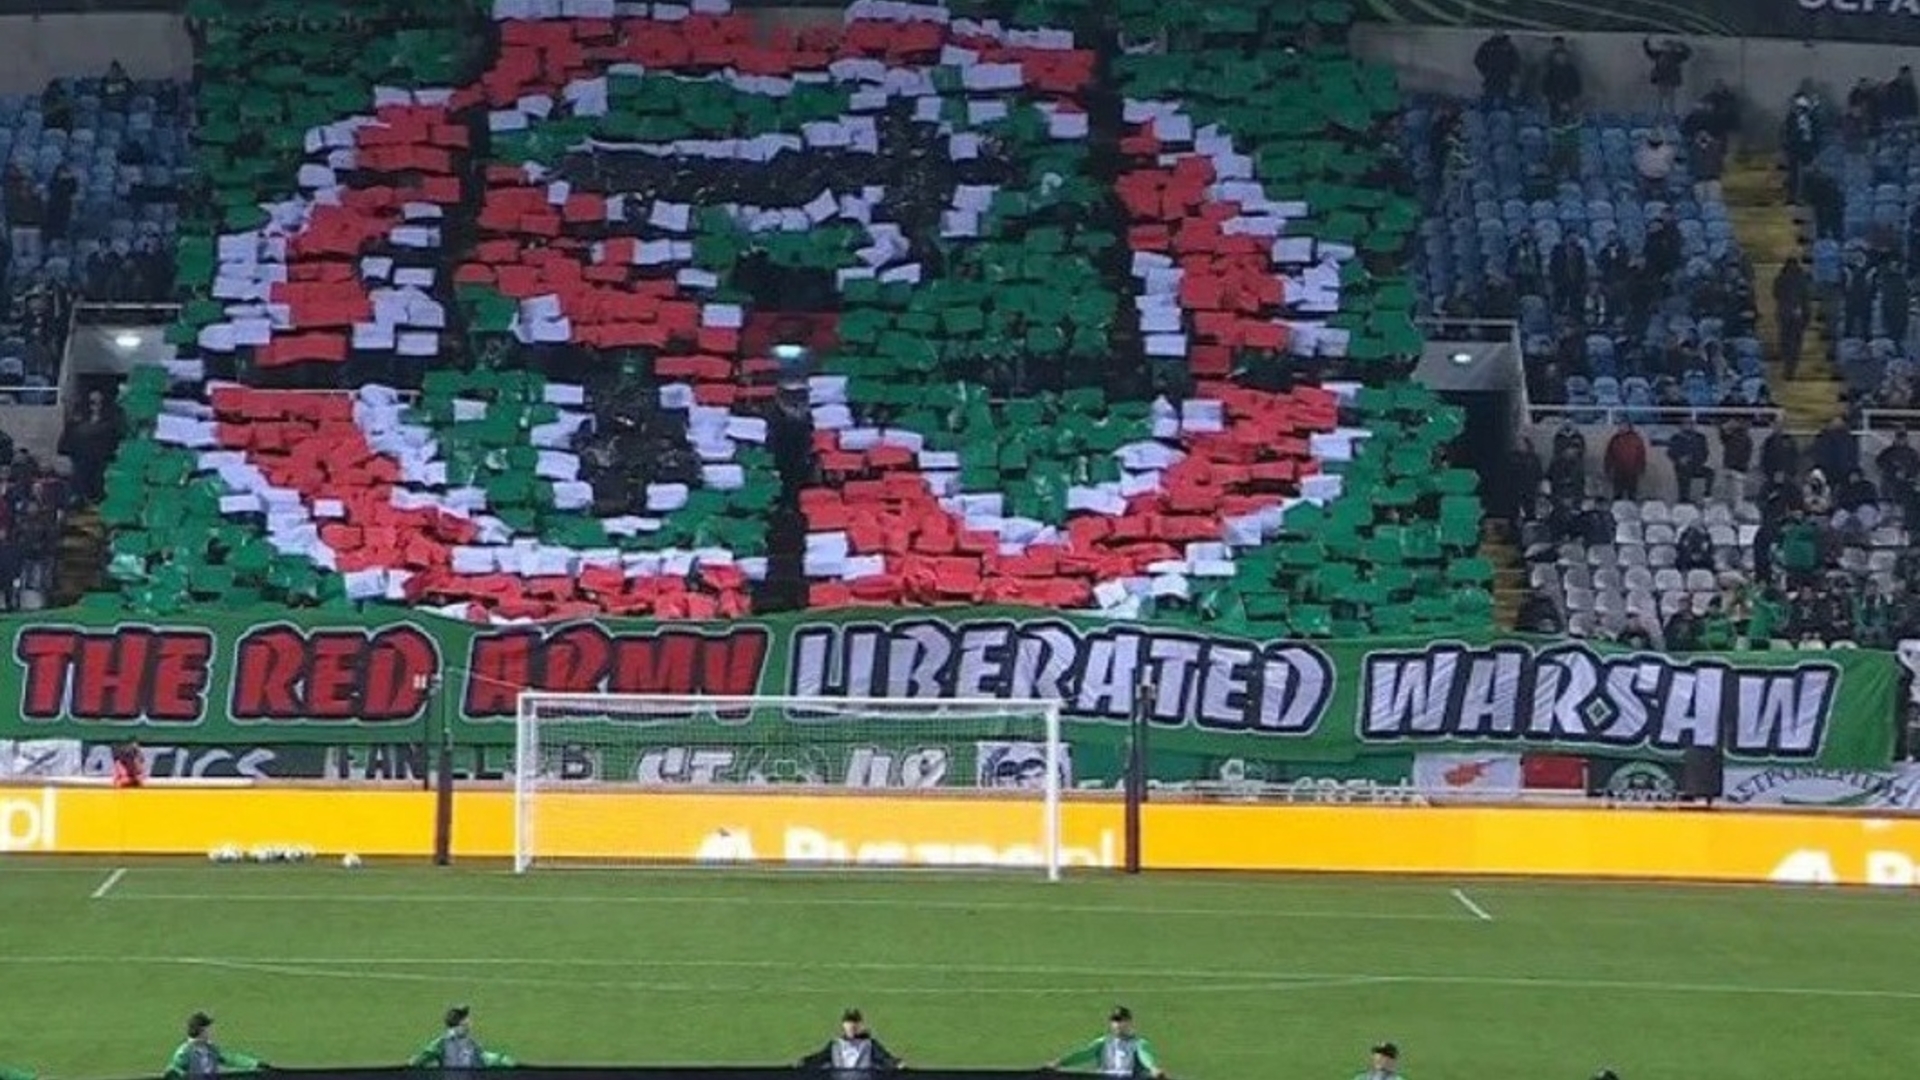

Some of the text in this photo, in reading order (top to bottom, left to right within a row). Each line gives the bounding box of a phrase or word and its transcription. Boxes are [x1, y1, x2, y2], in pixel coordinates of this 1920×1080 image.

[17, 622, 1838, 757] THE RED ARMY LIBERATED WARSAW
